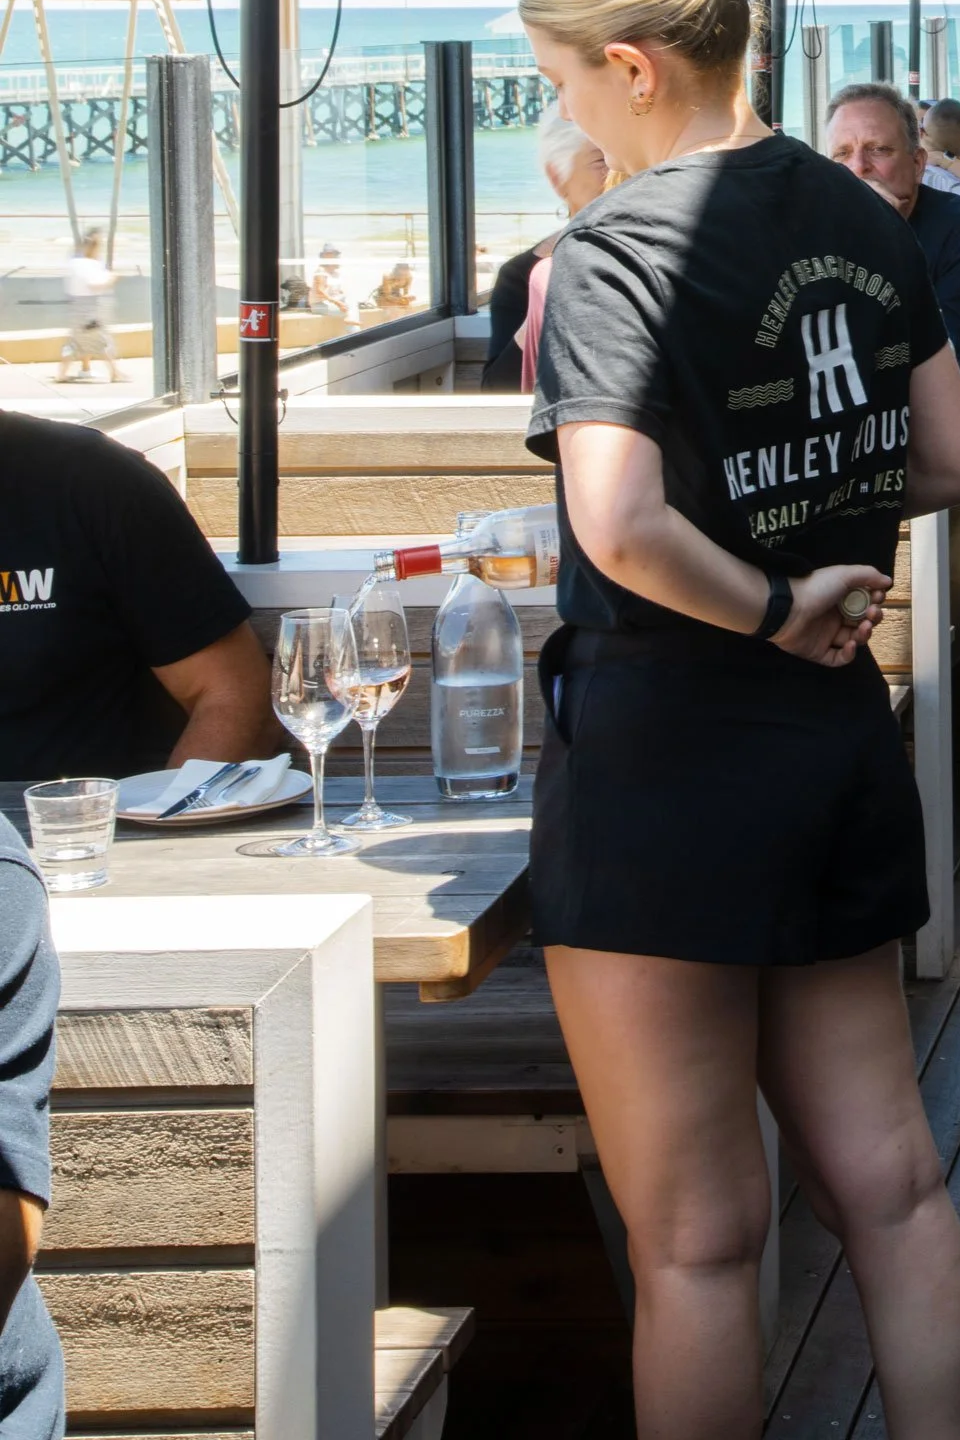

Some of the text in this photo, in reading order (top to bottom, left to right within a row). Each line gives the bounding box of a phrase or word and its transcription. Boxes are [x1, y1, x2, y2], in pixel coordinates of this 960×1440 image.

[723, 406, 911, 501] HENLEY HOUS
[874, 467, 906, 494] WES
